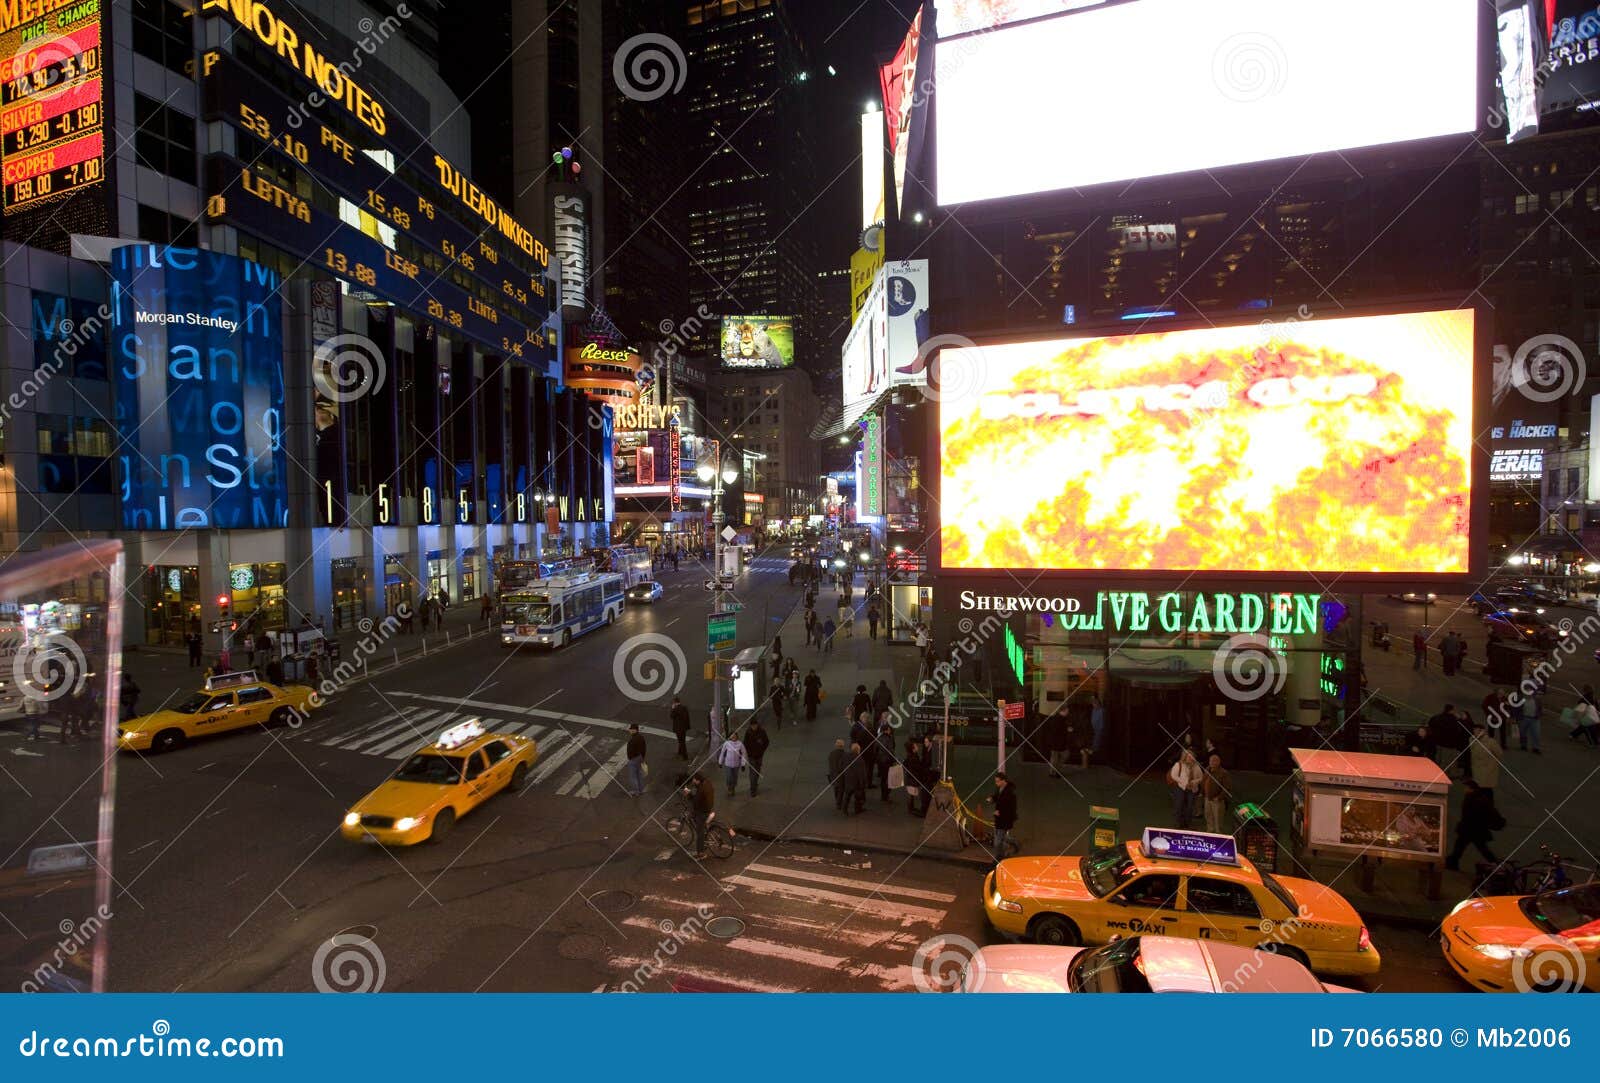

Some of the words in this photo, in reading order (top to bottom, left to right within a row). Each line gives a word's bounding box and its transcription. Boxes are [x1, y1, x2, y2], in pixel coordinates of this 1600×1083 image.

[22, 20, 49, 42] PRICE
[58, 1, 98, 28] CHANGE
[1, 52, 37, 82] GOLD
[9, 68, 48, 99] 712.90
[61, 48, 96, 79] -5.40
[202, 0, 301, 69] NIOR
[304, 42, 386, 136] NOTES
[2, 103, 42, 132] SILVER
[16, 122, 49, 150] 9.290
[56, 104, 97, 133] -0.190
[239, 102, 309, 165] 53.10
[320, 126, 355, 166] PFE
[5, 152, 55, 182] COPPER
[13, 174, 51, 203] 159.00
[64, 158, 99, 183] -7.00
[242, 167, 312, 224] LBTYA
[367, 189, 411, 230] 15.83
[418, 196, 435, 221] PG
[461, 178, 496, 225] LEAD
[498, 207, 533, 257] NIKKEI
[534, 239, 549, 267] FU
[326, 247, 377, 288] 13.88
[385, 250, 420, 279] LEAP
[480, 242, 498, 265] PRU
[136, 311, 185, 326] Morgan
[186, 312, 238, 332] Stanley
[580, 342, 631, 362] Reese's
[868, 421, 878, 463] OLIVE
[1509, 425, 1556, 438] HACKER
[868, 466, 878, 514] GARDEN
[1158, 591, 1321, 635] GARDEN
[1171, 839, 1217, 850] CUPCAKE
[1107, 920, 1127, 930] NYC
[1128, 918, 1166, 935] TAXI
